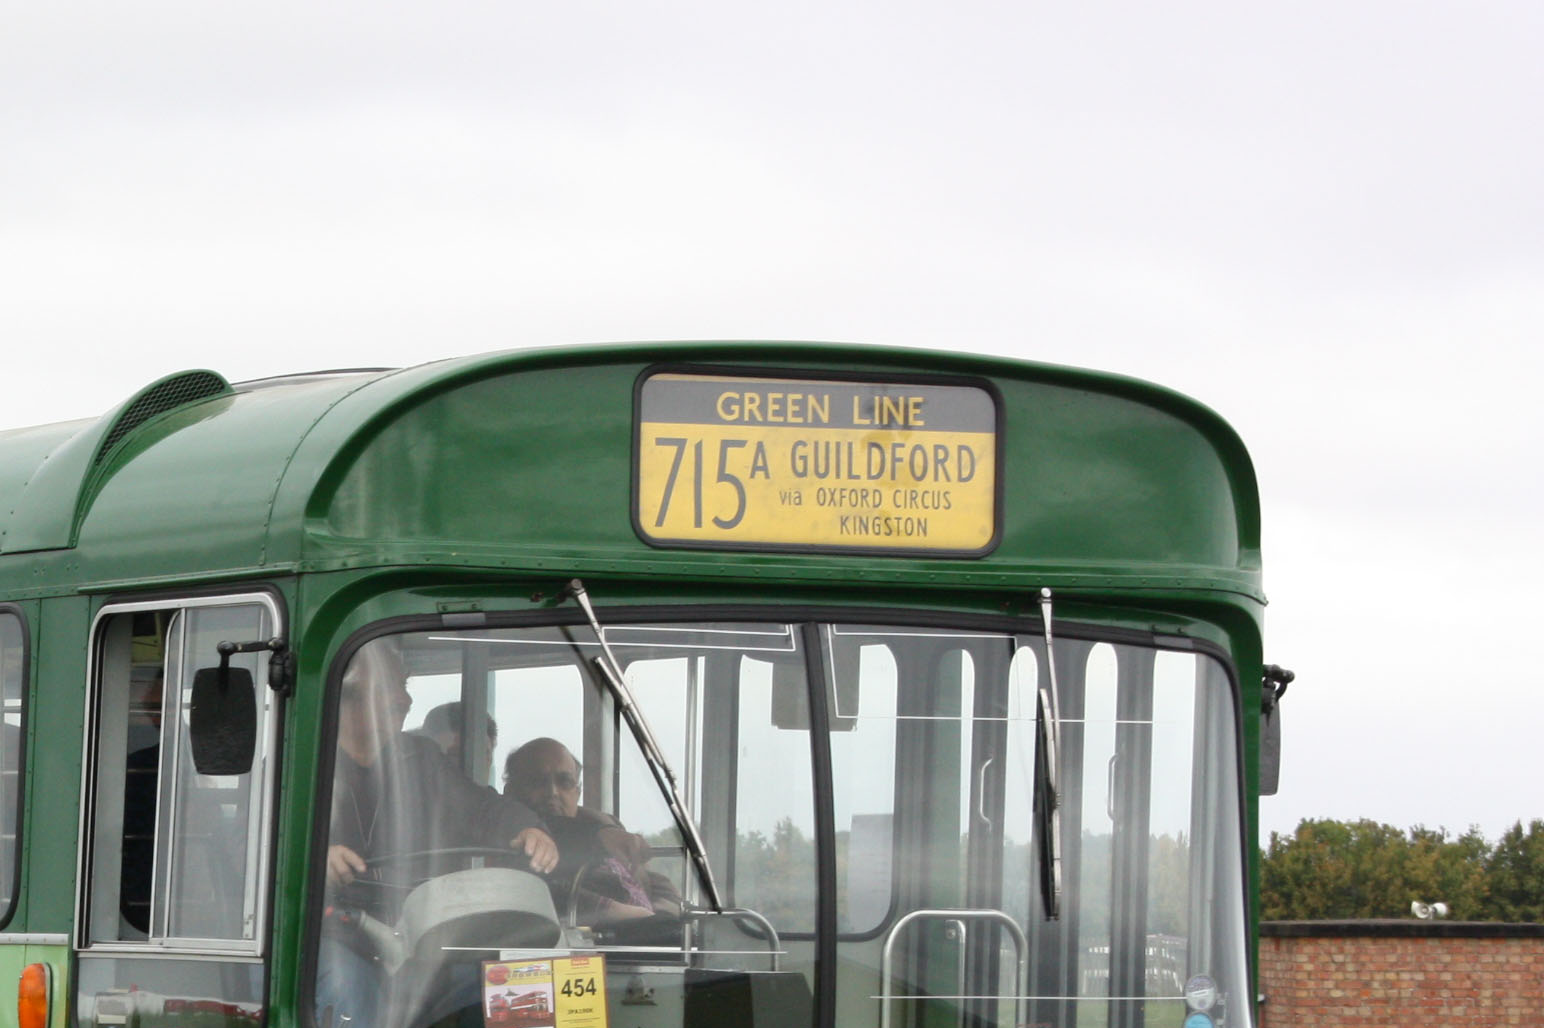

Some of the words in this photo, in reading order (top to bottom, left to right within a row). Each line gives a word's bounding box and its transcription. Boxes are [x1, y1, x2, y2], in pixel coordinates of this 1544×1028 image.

[716, 391, 830, 424] GREEN
[852, 395, 926, 427] LINE
[790, 439, 976, 483] GUILDFORD
[779, 489, 803, 507] via
[816, 488, 882, 508] OXFORD
[893, 490, 952, 511] CIRCUS
[839, 515, 928, 537] KINGSTON
[561, 977, 597, 997] 454
